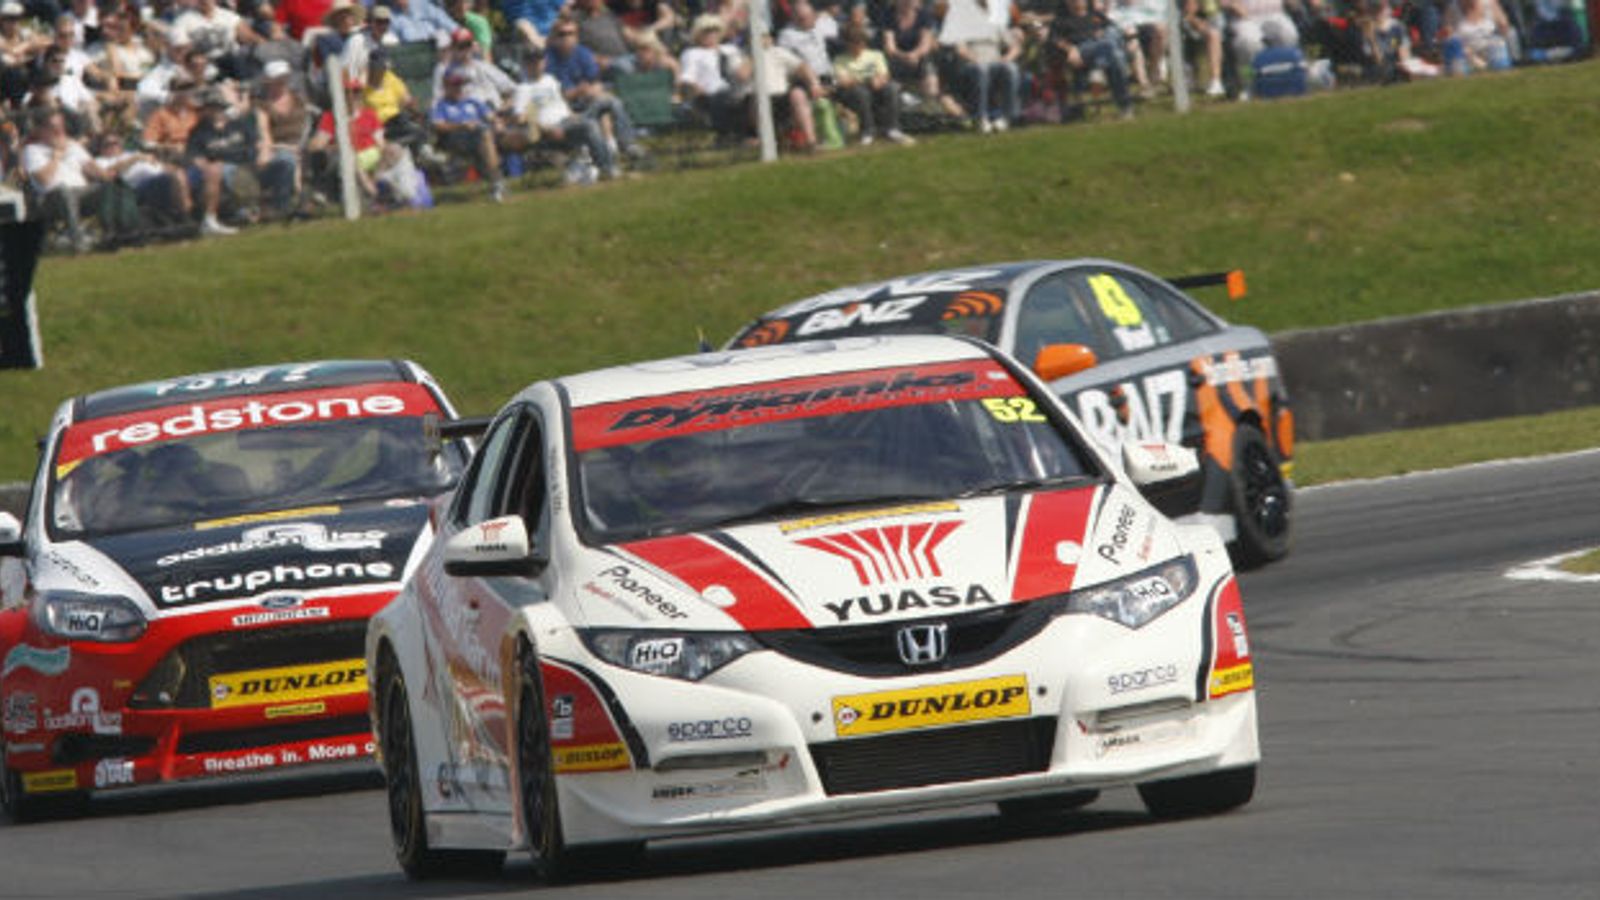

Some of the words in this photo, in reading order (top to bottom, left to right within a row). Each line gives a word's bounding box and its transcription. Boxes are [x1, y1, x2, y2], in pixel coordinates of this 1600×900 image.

[92, 395, 405, 451] redstone
[982, 397, 1046, 423] 52
[161, 562, 394, 602] truphone
[598, 565, 688, 620] Pioneer
[824, 584, 996, 622] YUASA
[238, 668, 366, 696] DUNLOP
[869, 686, 1025, 721] DUNLOP
[204, 752, 276, 772] Breathe
[282, 748, 303, 763] in.
[308, 743, 357, 761] Move
